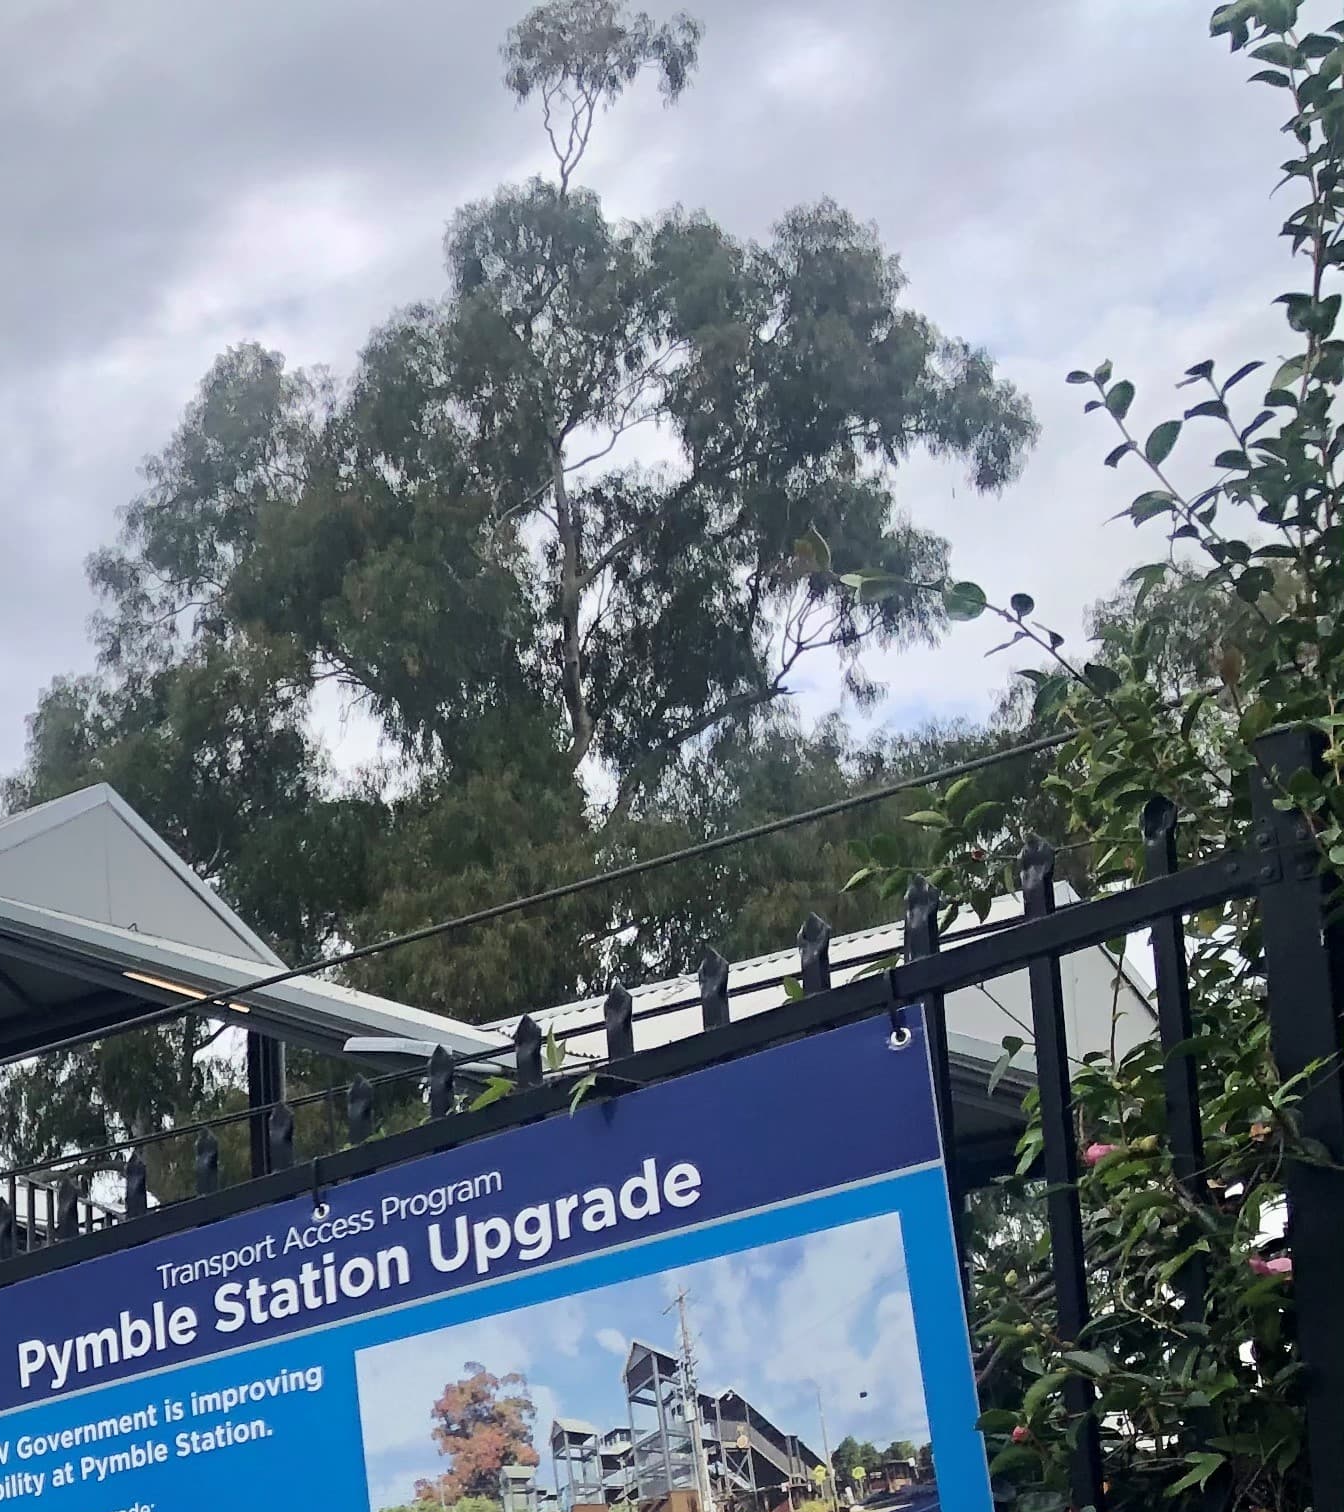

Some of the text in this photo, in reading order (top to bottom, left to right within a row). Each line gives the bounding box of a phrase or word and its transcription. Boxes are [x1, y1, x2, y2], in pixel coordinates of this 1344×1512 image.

[18, 1157, 702, 1389] Pymble Station Upgrade
[157, 1170, 503, 1289] Transport Access Program
[16, 1404, 158, 1459] Government
[164, 1399, 184, 1422] is
[190, 1365, 322, 1416] improving
[52, 1462, 74, 1487] at
[80, 1440, 169, 1481] Pymble
[175, 1417, 273, 1457] Station.
